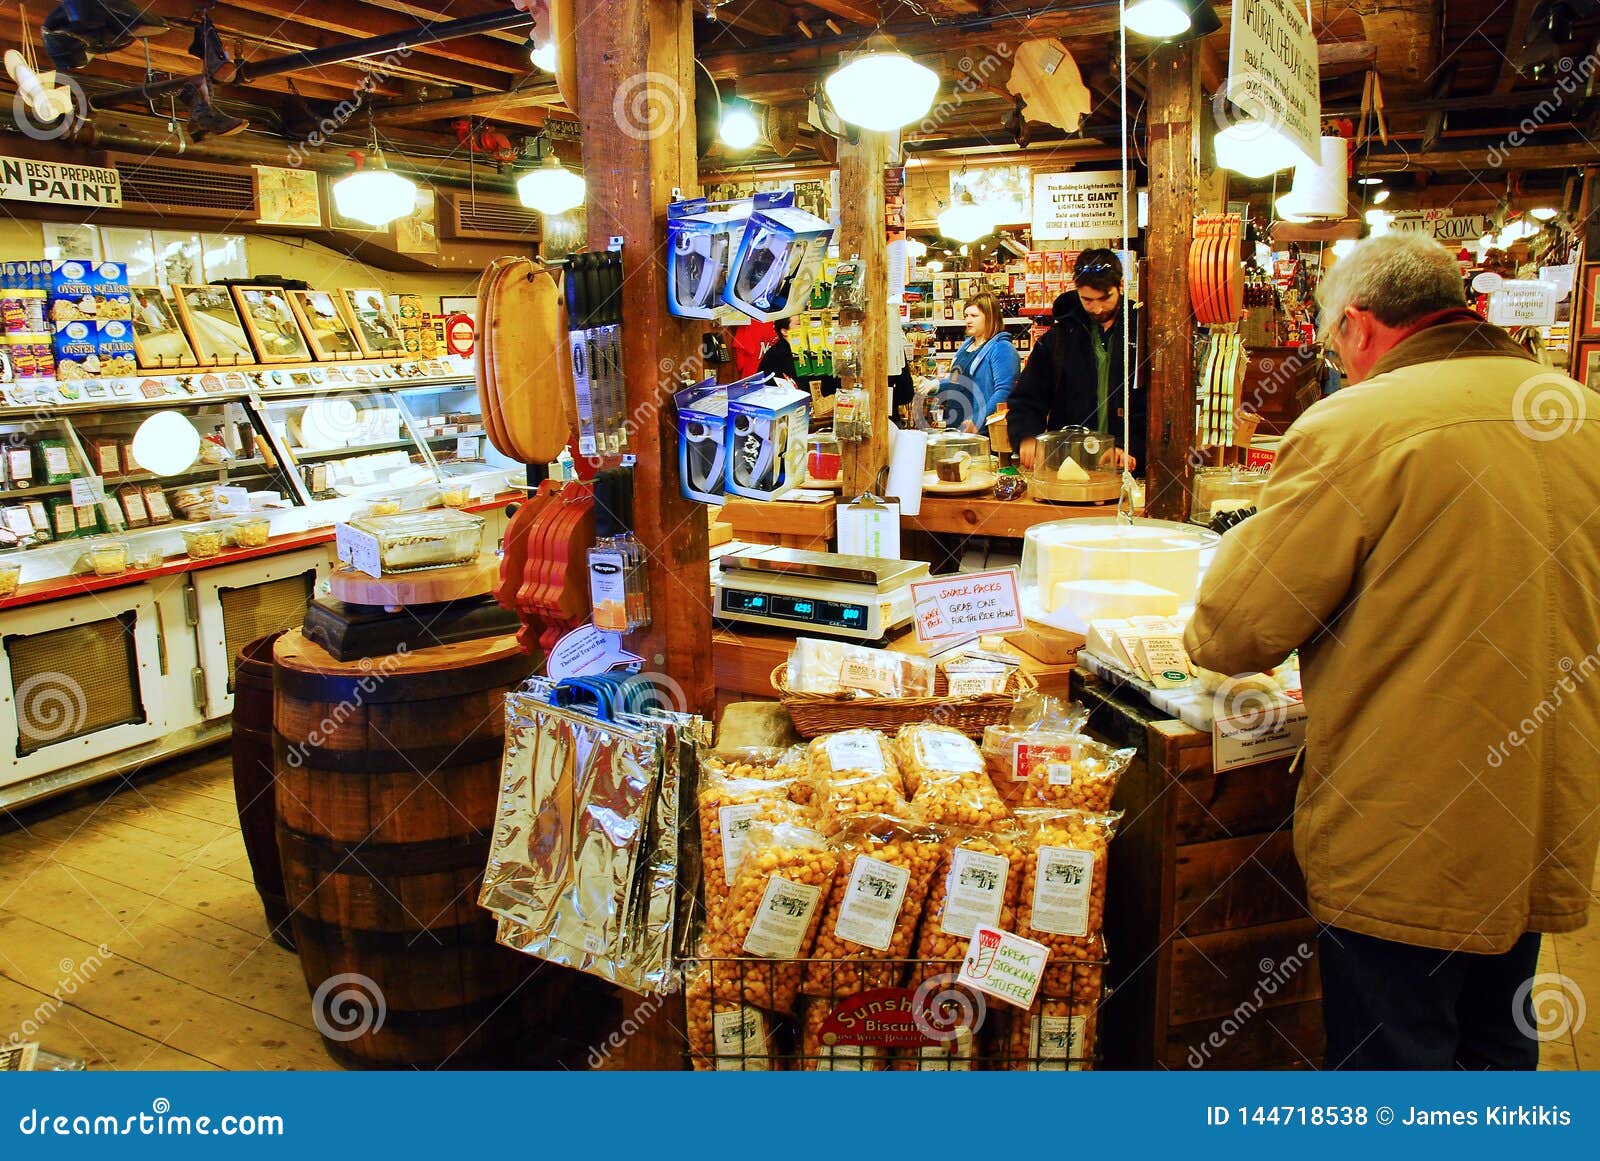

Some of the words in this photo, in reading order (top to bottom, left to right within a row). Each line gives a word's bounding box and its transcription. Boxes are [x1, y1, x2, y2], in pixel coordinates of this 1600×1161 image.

[25, 162, 56, 179] BEST
[60, 166, 116, 185] PREPARED
[28, 178, 119, 204] PAINT.
[1052, 193, 1084, 203] LITTLE
[1087, 192, 1119, 202] GIANT
[1433, 218, 1479, 239] ROOM
[57, 284, 92, 295] OYSTER
[62, 344, 96, 354] OYSTER
[940, 587, 972, 599] SNACK
[973, 582, 1002, 594] PACKS
[949, 602, 973, 613] GRAB
[976, 598, 997, 609] ONE
[951, 616, 965, 625] FOR
[966, 613, 978, 623] THE
[978, 611, 995, 621] RIDE
[1000, 945, 1039, 966] GREAT
[993, 960, 1037, 985] STOCKING
[986, 974, 1031, 1003] STUFFER
[837, 996, 944, 1029] Sunshine
[866, 1020, 930, 1032] Biscuits
